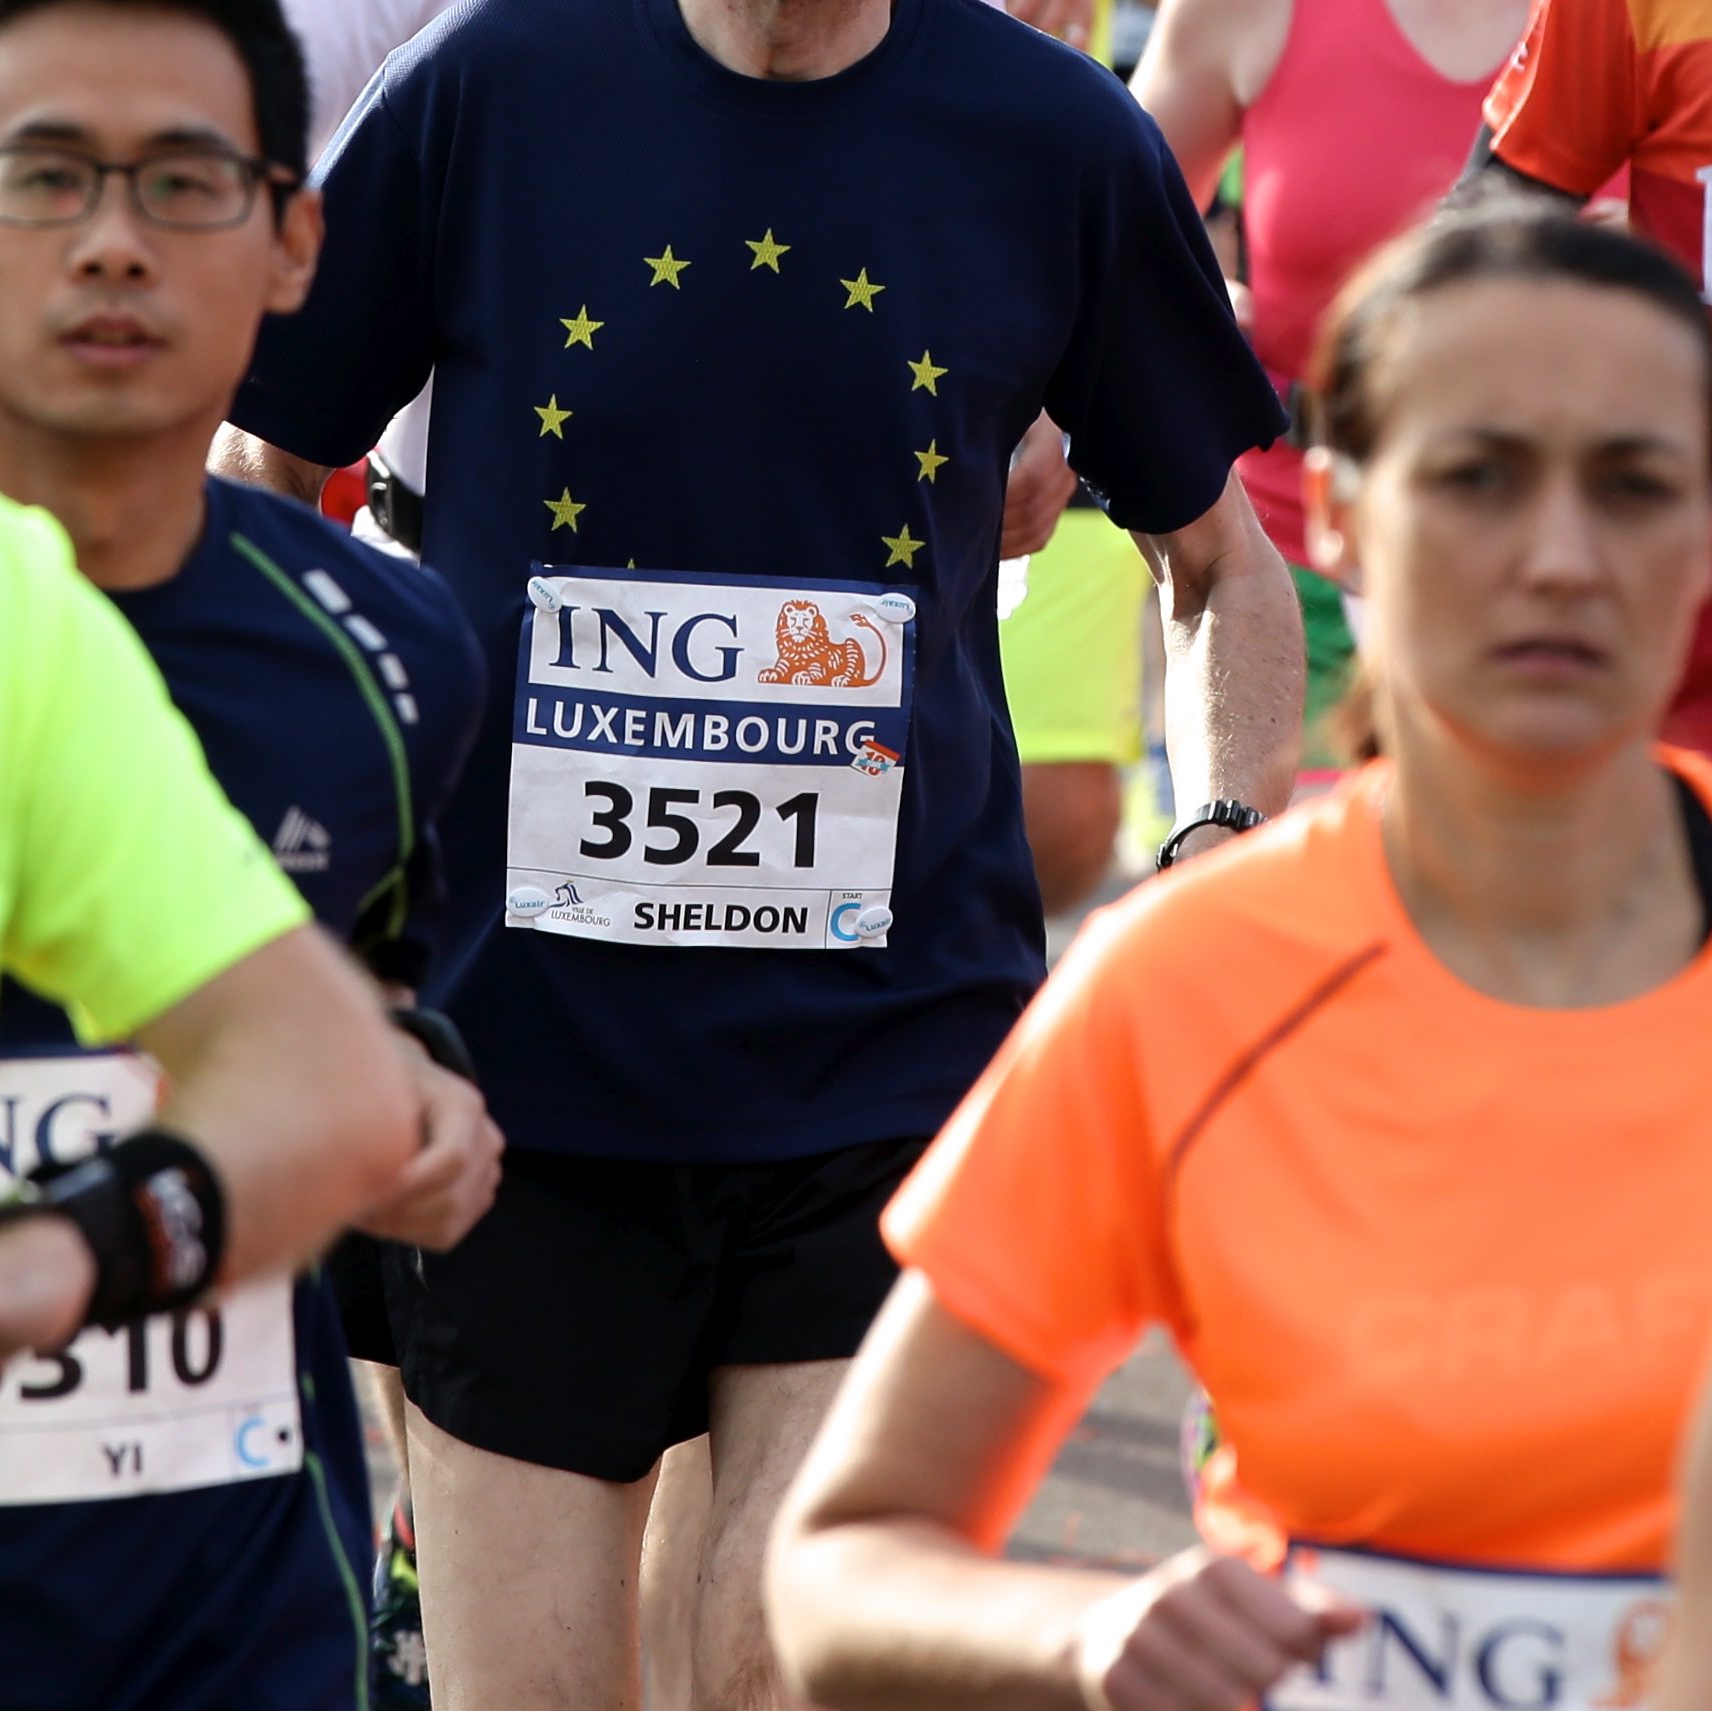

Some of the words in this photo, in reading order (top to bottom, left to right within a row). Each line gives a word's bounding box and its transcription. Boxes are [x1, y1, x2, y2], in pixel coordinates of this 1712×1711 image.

[548, 604, 745, 683] ING
[526, 697, 876, 756] LUXEMBOURG
[578, 780, 820, 869] 3521
[550, 910, 611, 927] LUXEMBOURG
[633, 902, 808, 934] SHELDON
[830, 902, 862, 942] C
[100, 1442, 144, 1477] YI
